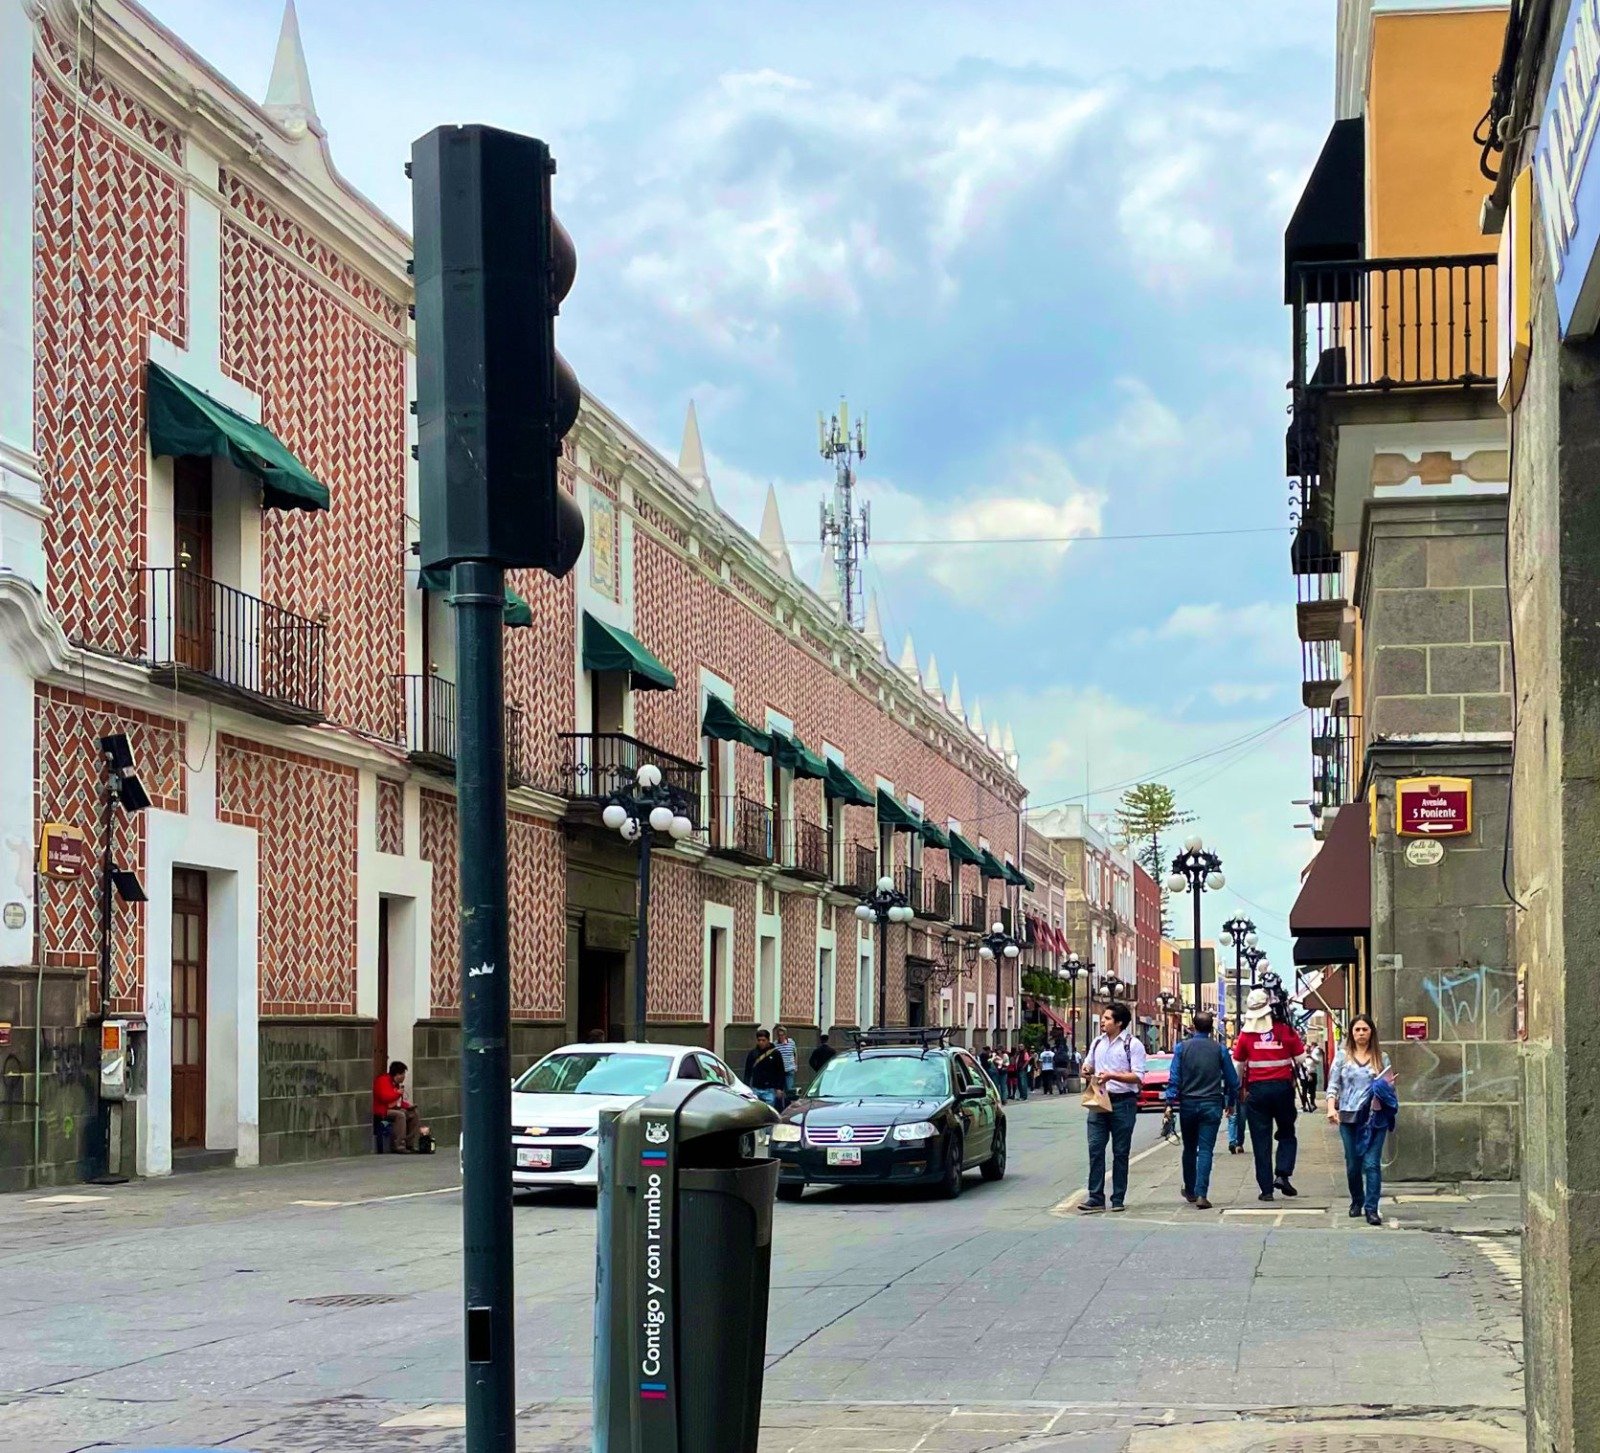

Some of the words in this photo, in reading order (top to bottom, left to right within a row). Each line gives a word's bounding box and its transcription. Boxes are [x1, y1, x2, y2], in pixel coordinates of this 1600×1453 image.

[1413, 808, 1418, 818] 5
[1420, 808, 1456, 818] Poniente
[1421, 798, 1447, 806] Avenida
[643, 1173, 661, 1240] rumbo
[647, 1245, 660, 1279] con
[647, 1282, 665, 1296] y
[642, 1299, 665, 1376] Contigo
